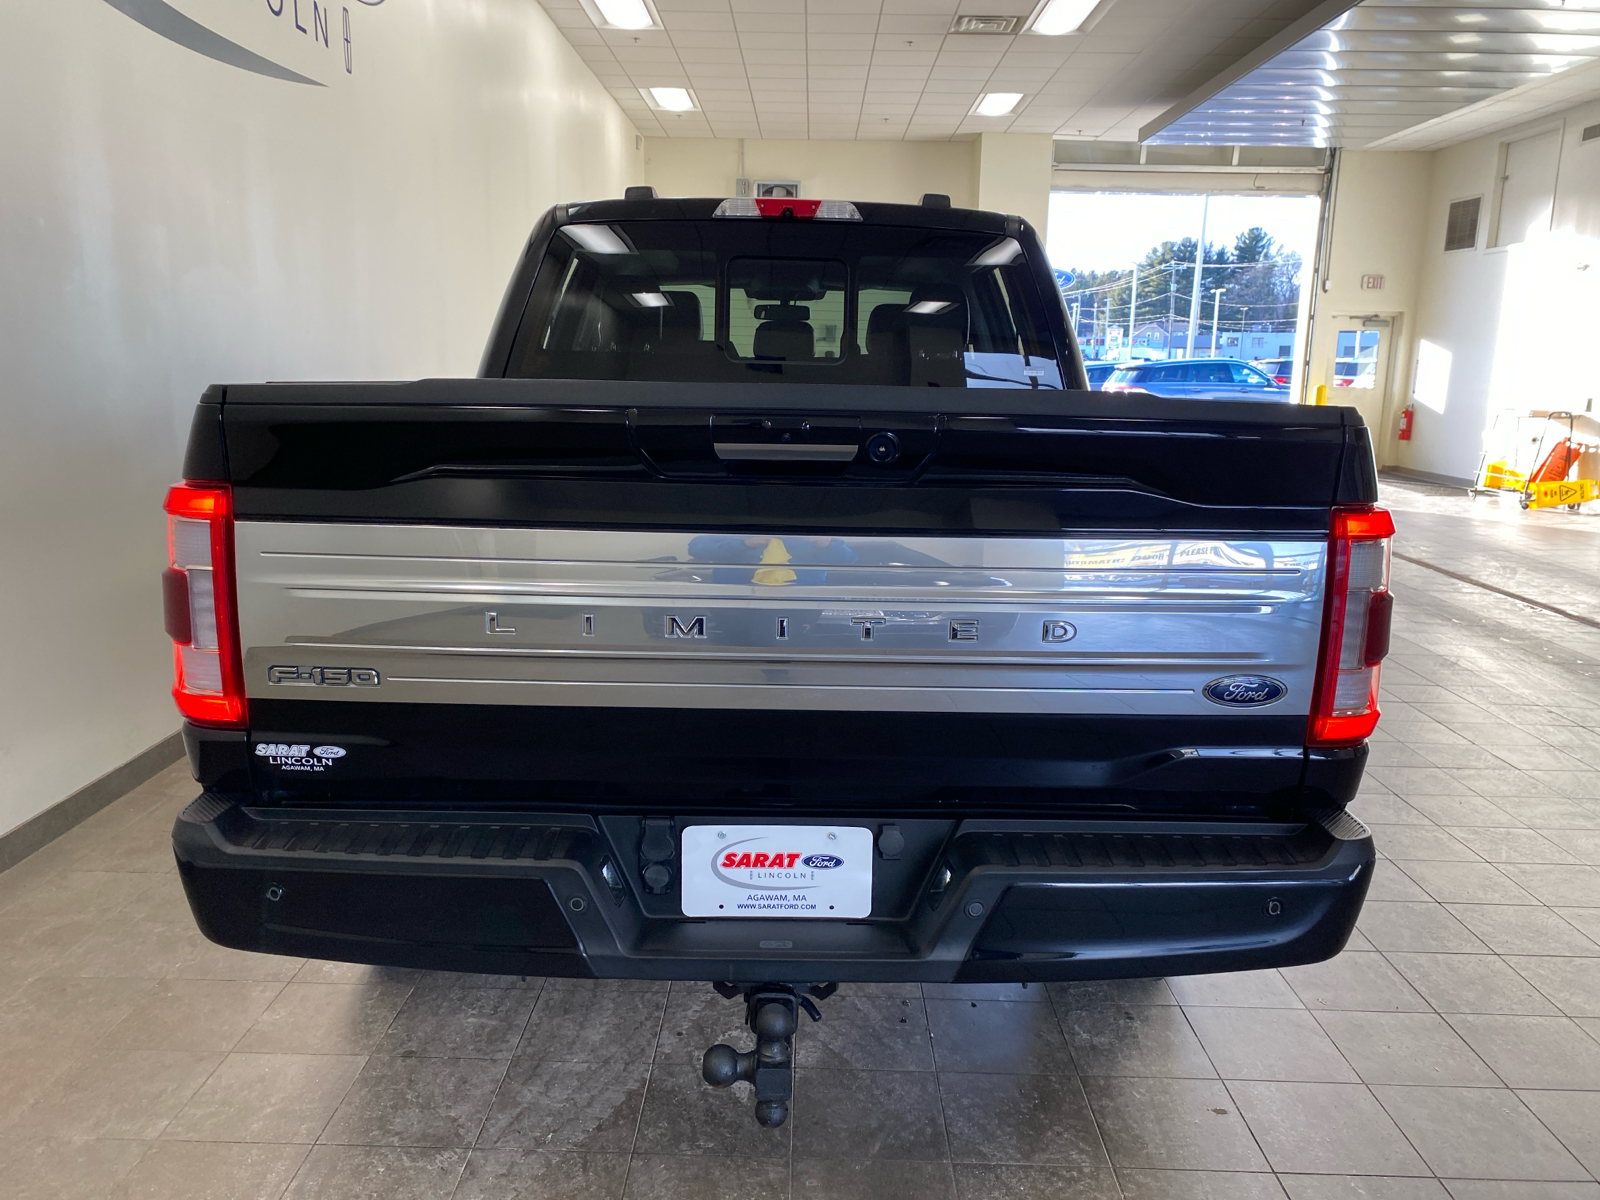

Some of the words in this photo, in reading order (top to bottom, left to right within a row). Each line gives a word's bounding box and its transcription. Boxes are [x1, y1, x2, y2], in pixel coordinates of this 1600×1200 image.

[1366, 276, 1384, 290] EXIT
[485, 611, 1078, 643] LIMITED
[267, 665, 380, 687] F-150
[1223, 682, 1269, 701] Ford
[255, 743, 311, 757] SARAT
[318, 747, 341, 757] Ford
[269, 756, 333, 766] LINCOLN
[721, 852, 801, 869] SARAT
[808, 855, 837, 868] Ford
[746, 893, 790, 903] AGAWAM,
[792, 894, 808, 902] MA
